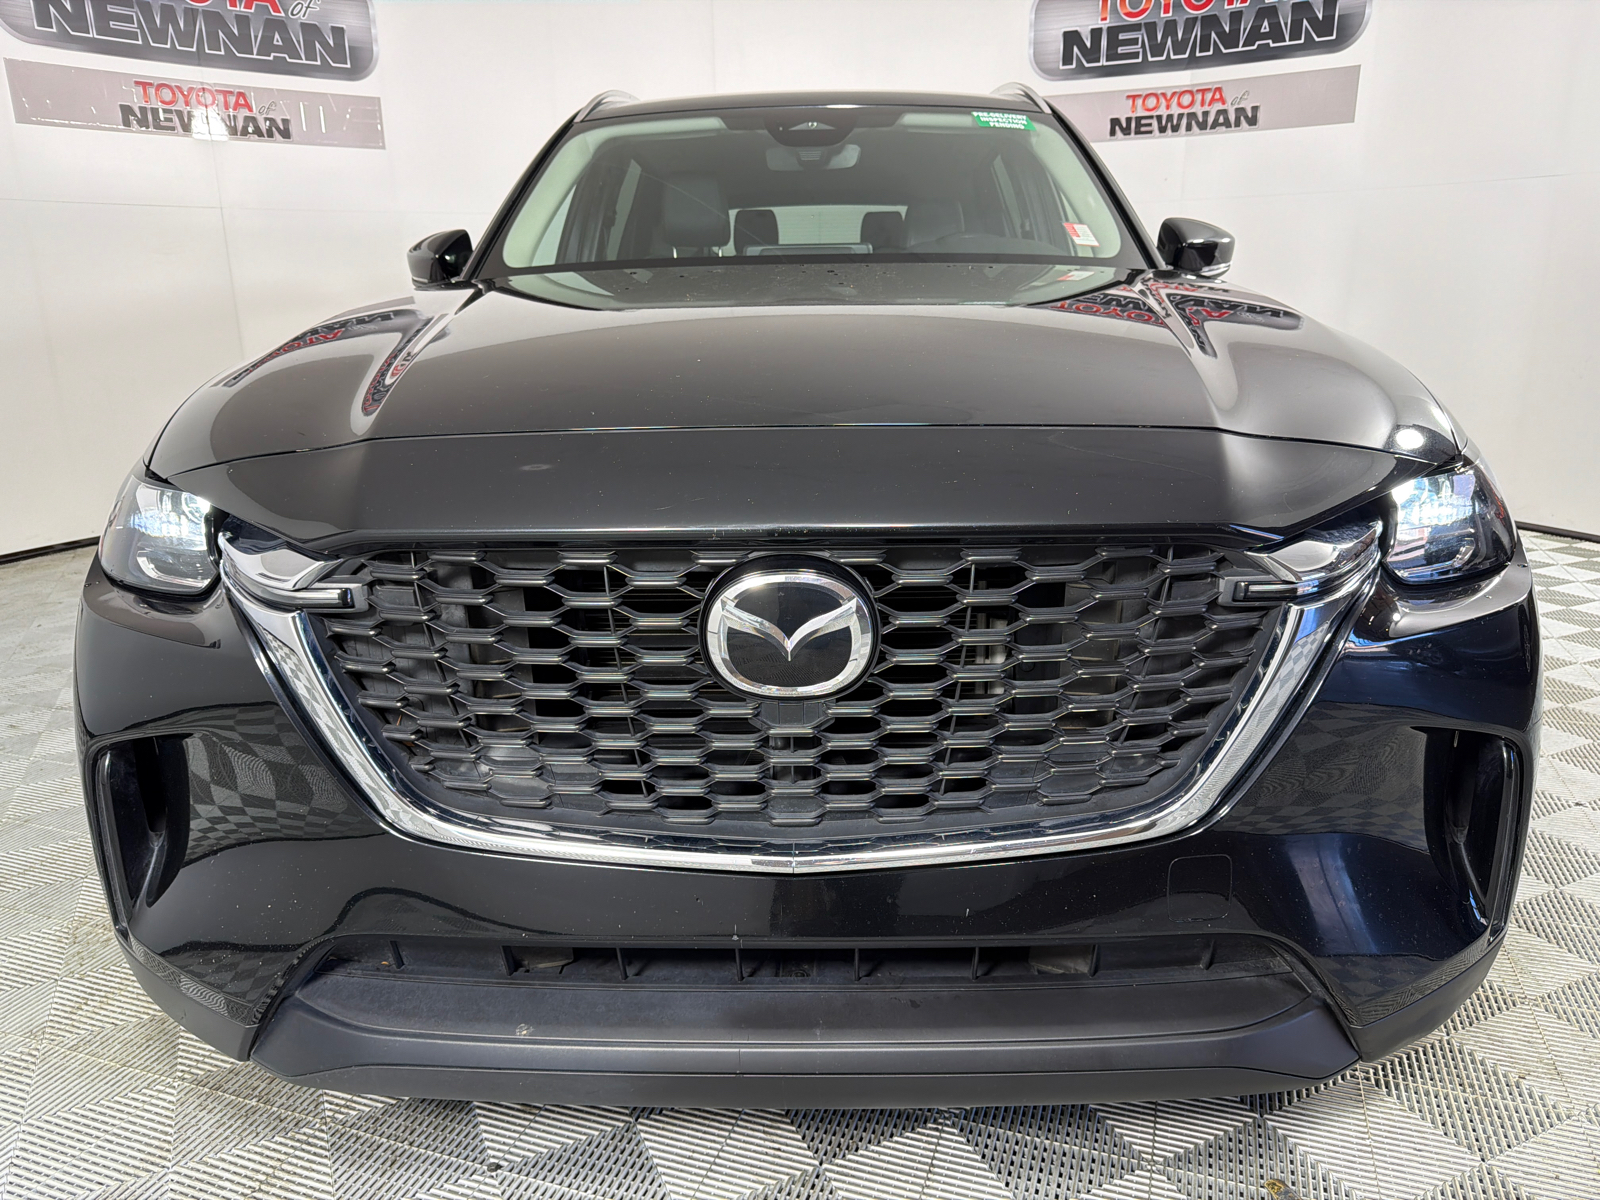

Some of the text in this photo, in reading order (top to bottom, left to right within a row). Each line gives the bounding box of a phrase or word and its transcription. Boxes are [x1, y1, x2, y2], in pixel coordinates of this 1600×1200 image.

[31, 0, 351, 68] NEWNAN
[1059, 0, 1338, 69] NEWNAN
[133, 80, 276, 116] TOYOTA of
[1126, 86, 1249, 113] TOYOTA of
[1109, 105, 1260, 137] NEWNAN
